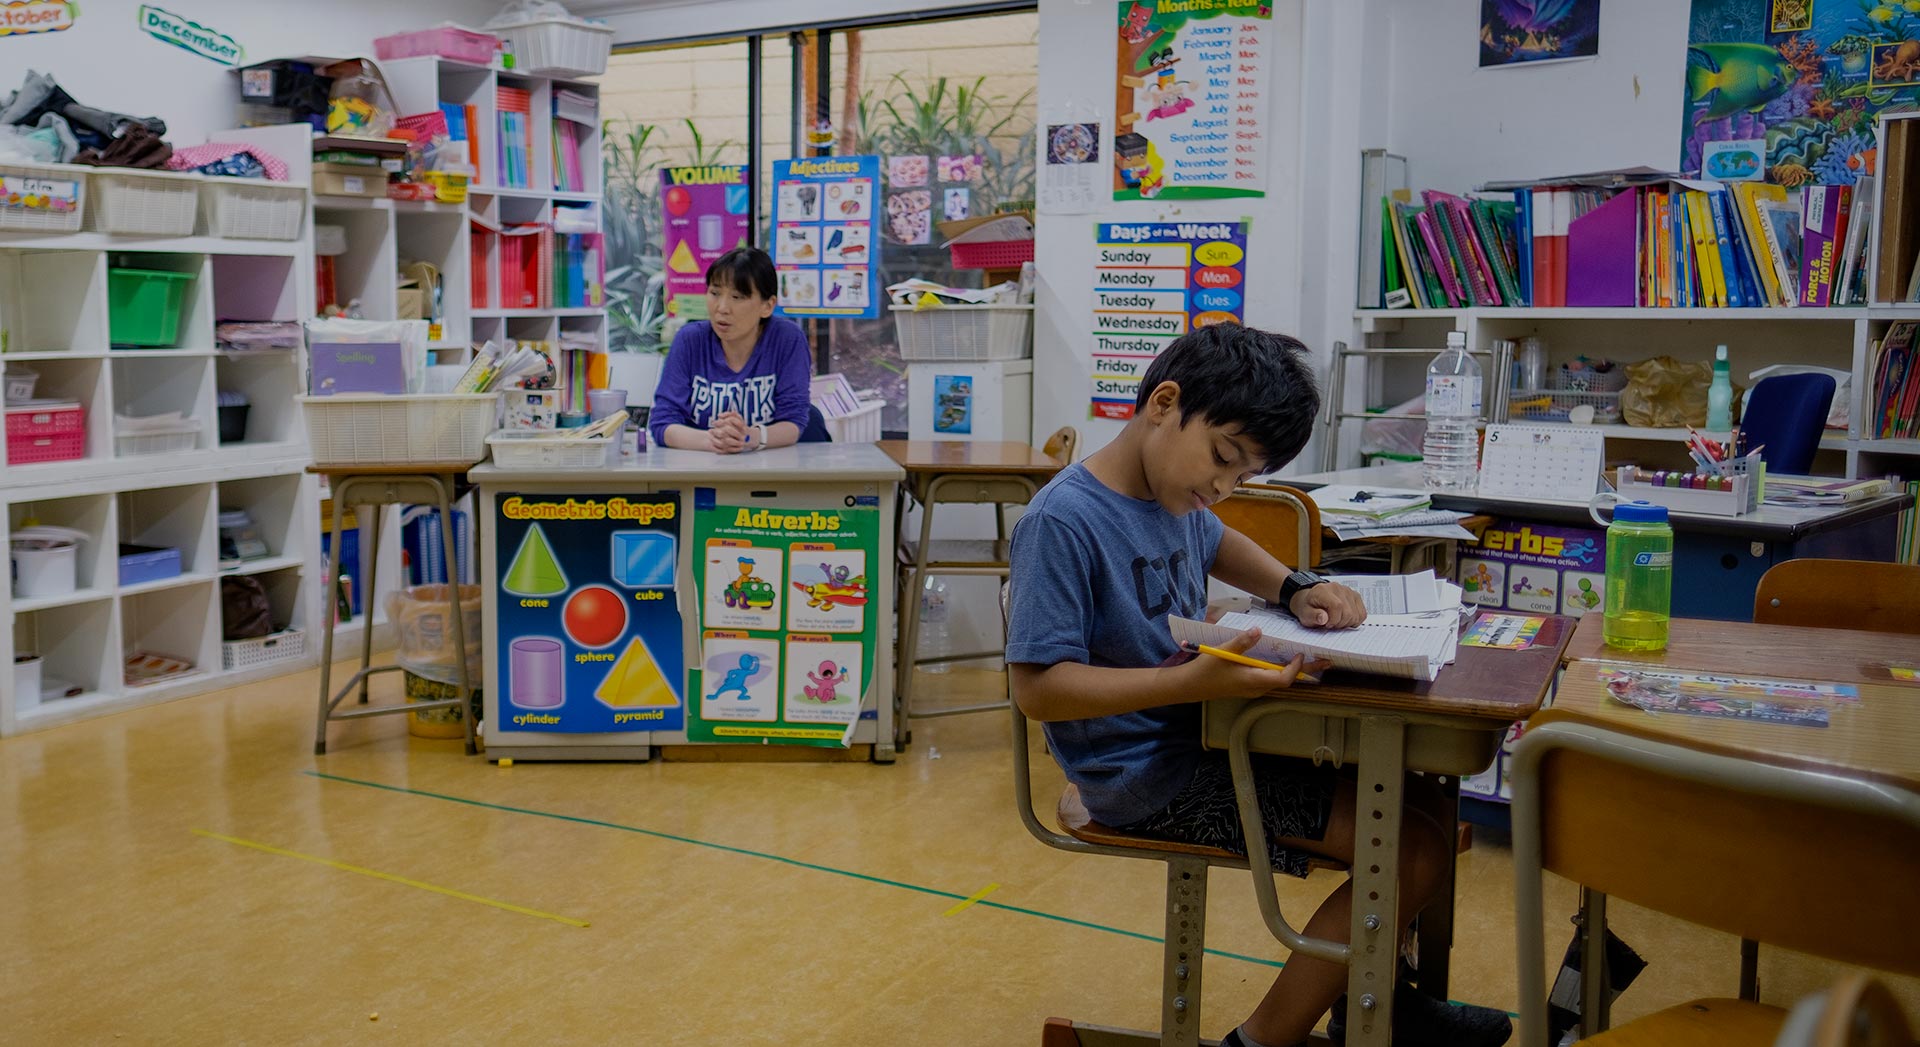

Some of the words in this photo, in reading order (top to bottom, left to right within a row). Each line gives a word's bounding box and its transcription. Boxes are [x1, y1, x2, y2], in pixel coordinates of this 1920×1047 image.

[1158, 0, 1212, 14] Months
[0, 9, 61, 26] tober
[148, 13, 237, 58] December
[1191, 26, 1232, 36] January
[1184, 40, 1232, 50] February
[1199, 51, 1232, 61] March
[1206, 64, 1231, 75] April
[1209, 78, 1229, 88] May
[1237, 77, 1255, 86] May
[1206, 91, 1229, 101] June
[1237, 91, 1258, 99] June
[1209, 105, 1228, 115] July
[1236, 104, 1253, 113] July
[1192, 119, 1228, 129] August
[1170, 132, 1228, 143] September
[1186, 145, 1228, 155] October
[789, 161, 860, 176] Adjectives
[1175, 159, 1228, 168] November
[670, 167, 742, 185] VOLUME
[1173, 172, 1228, 182] December
[22, 180, 53, 192] Extra
[1110, 225, 1151, 242] Days
[1177, 224, 1232, 239] Week
[1101, 251, 1151, 264] Sunday
[1206, 250, 1230, 260] Sun.
[1819, 241, 1833, 285] MOTION
[1810, 258, 1821, 269] &
[1100, 272, 1155, 286] Monday
[1202, 272, 1232, 283] Mon.
[1807, 268, 1819, 303] FORCE
[1100, 294, 1155, 308] Tuesday
[1203, 296, 1231, 306] Tues.
[1098, 316, 1179, 331] Wednesday
[1098, 338, 1160, 353] Thursday
[336, 351, 377, 365] Spelling
[1096, 360, 1137, 374] Friday
[1096, 381, 1139, 393] Saturd
[691, 373, 776, 428] PINK
[1490, 431, 1500, 442] 5
[502, 498, 606, 521] Geometric
[607, 498, 675, 525] Shapes
[734, 508, 840, 531] Adverbs
[1475, 547, 1490, 556] word
[1491, 549, 1504, 558] that
[1504, 550, 1519, 560] most
[1520, 552, 1536, 562] often
[1537, 555, 1557, 565] shows
[1558, 557, 1580, 567] action.
[1131, 548, 1208, 621] CO
[635, 590, 664, 600] cube
[1479, 594, 1499, 604] clean
[520, 598, 549, 608] cone
[1530, 601, 1552, 611] come
[575, 652, 615, 664] sphere
[513, 714, 561, 726] cylinder
[614, 710, 664, 723] pyramid
[1474, 782, 1491, 792] walk
